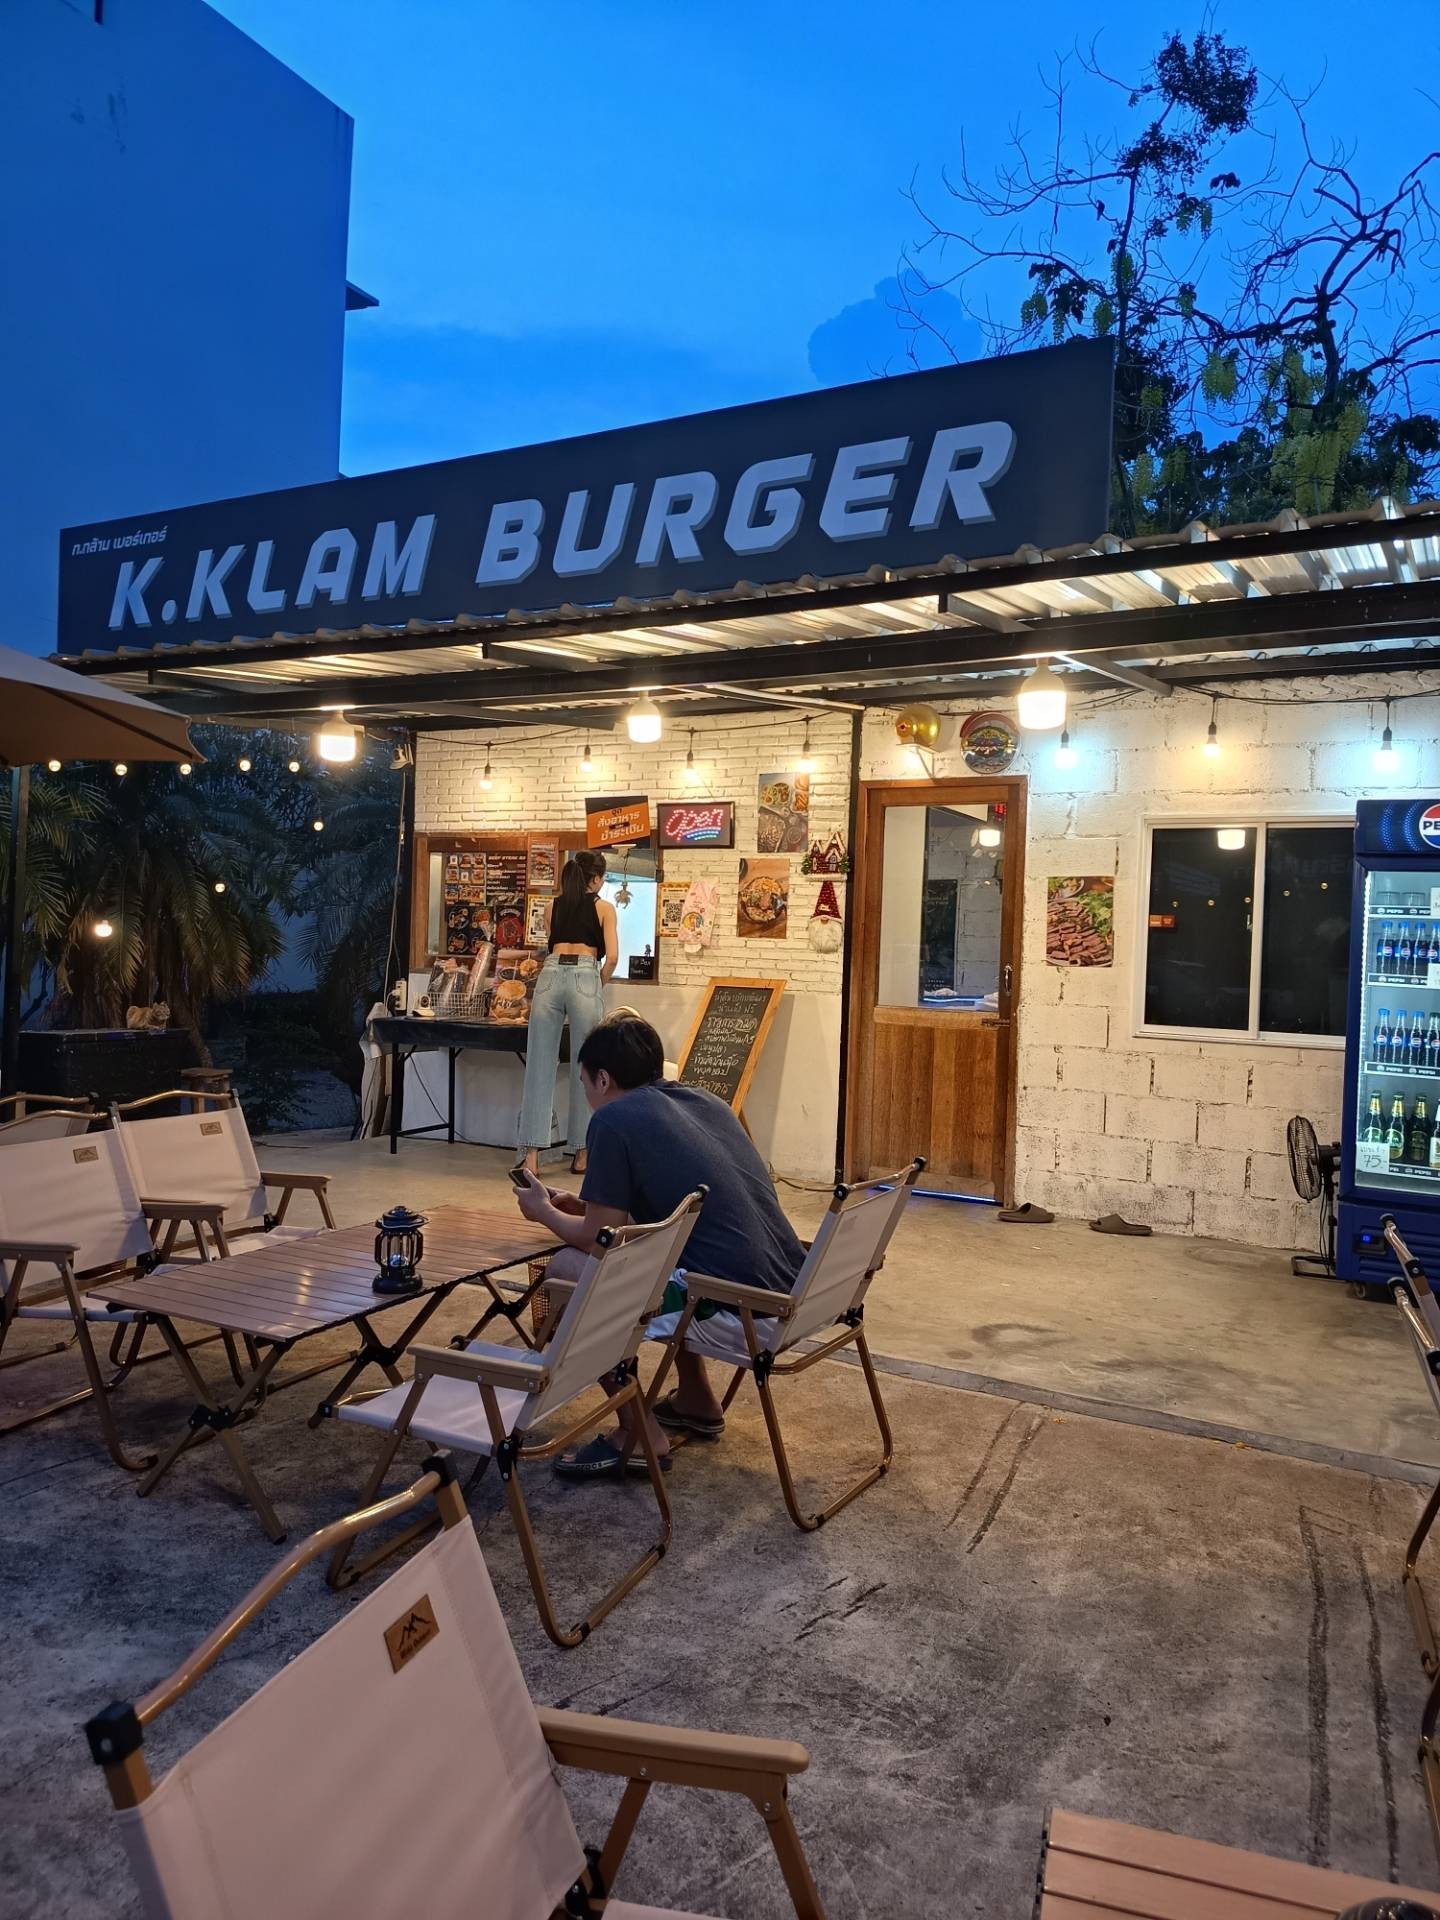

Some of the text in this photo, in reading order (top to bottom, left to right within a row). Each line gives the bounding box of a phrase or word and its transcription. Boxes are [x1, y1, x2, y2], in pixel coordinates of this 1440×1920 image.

[107, 419, 1019, 632] K.KLAM BURGER
[112, 525, 168, 549] เบอร์เกอร์
